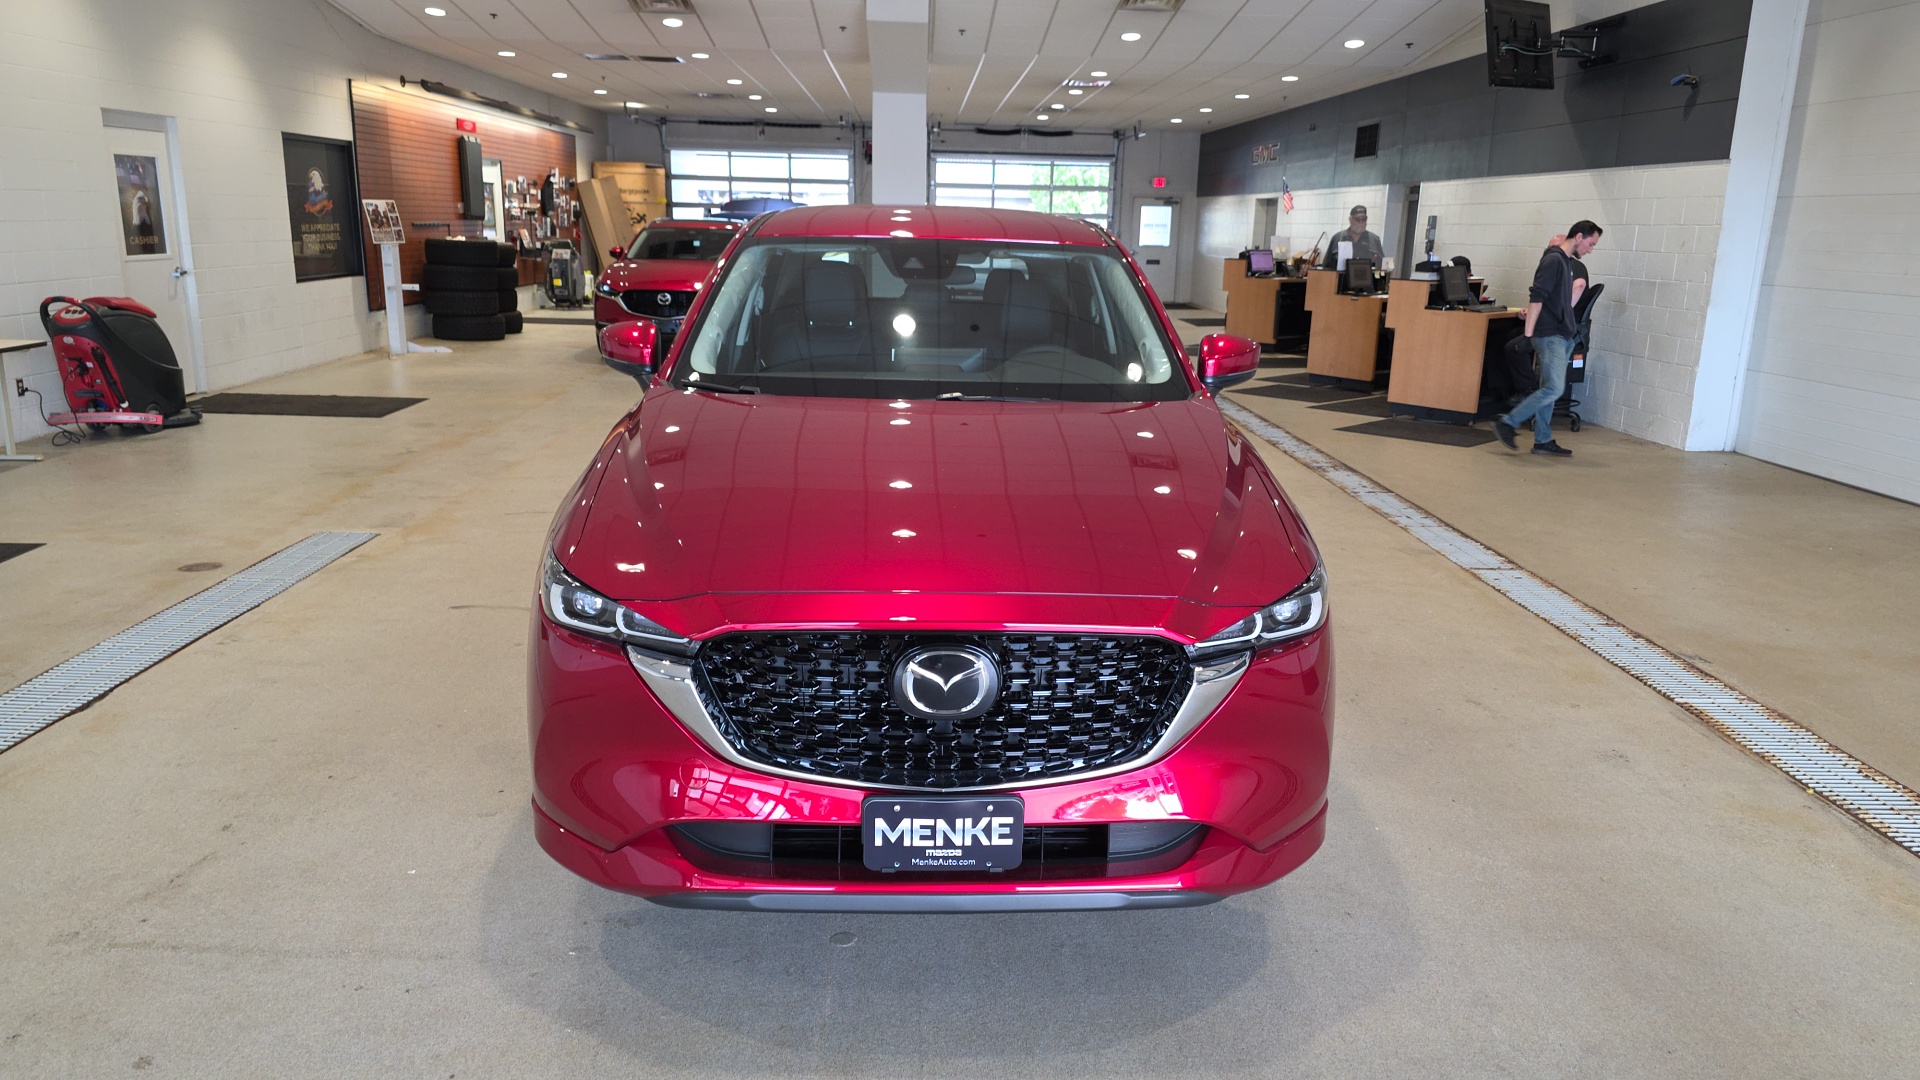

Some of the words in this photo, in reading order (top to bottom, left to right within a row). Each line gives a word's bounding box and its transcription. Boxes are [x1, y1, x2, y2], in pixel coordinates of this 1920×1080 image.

[1252, 143, 1280, 165] GMC
[301, 224, 310, 232] WE
[310, 223, 340, 232] APPRECIATE
[129, 235, 159, 245] CASHIER
[302, 233, 316, 242] YOUR
[308, 243, 325, 251] THANK
[874, 816, 1014, 847] MENKE
[925, 849, 963, 857] mazda
[911, 858, 976, 866] MenkeAuto.com
